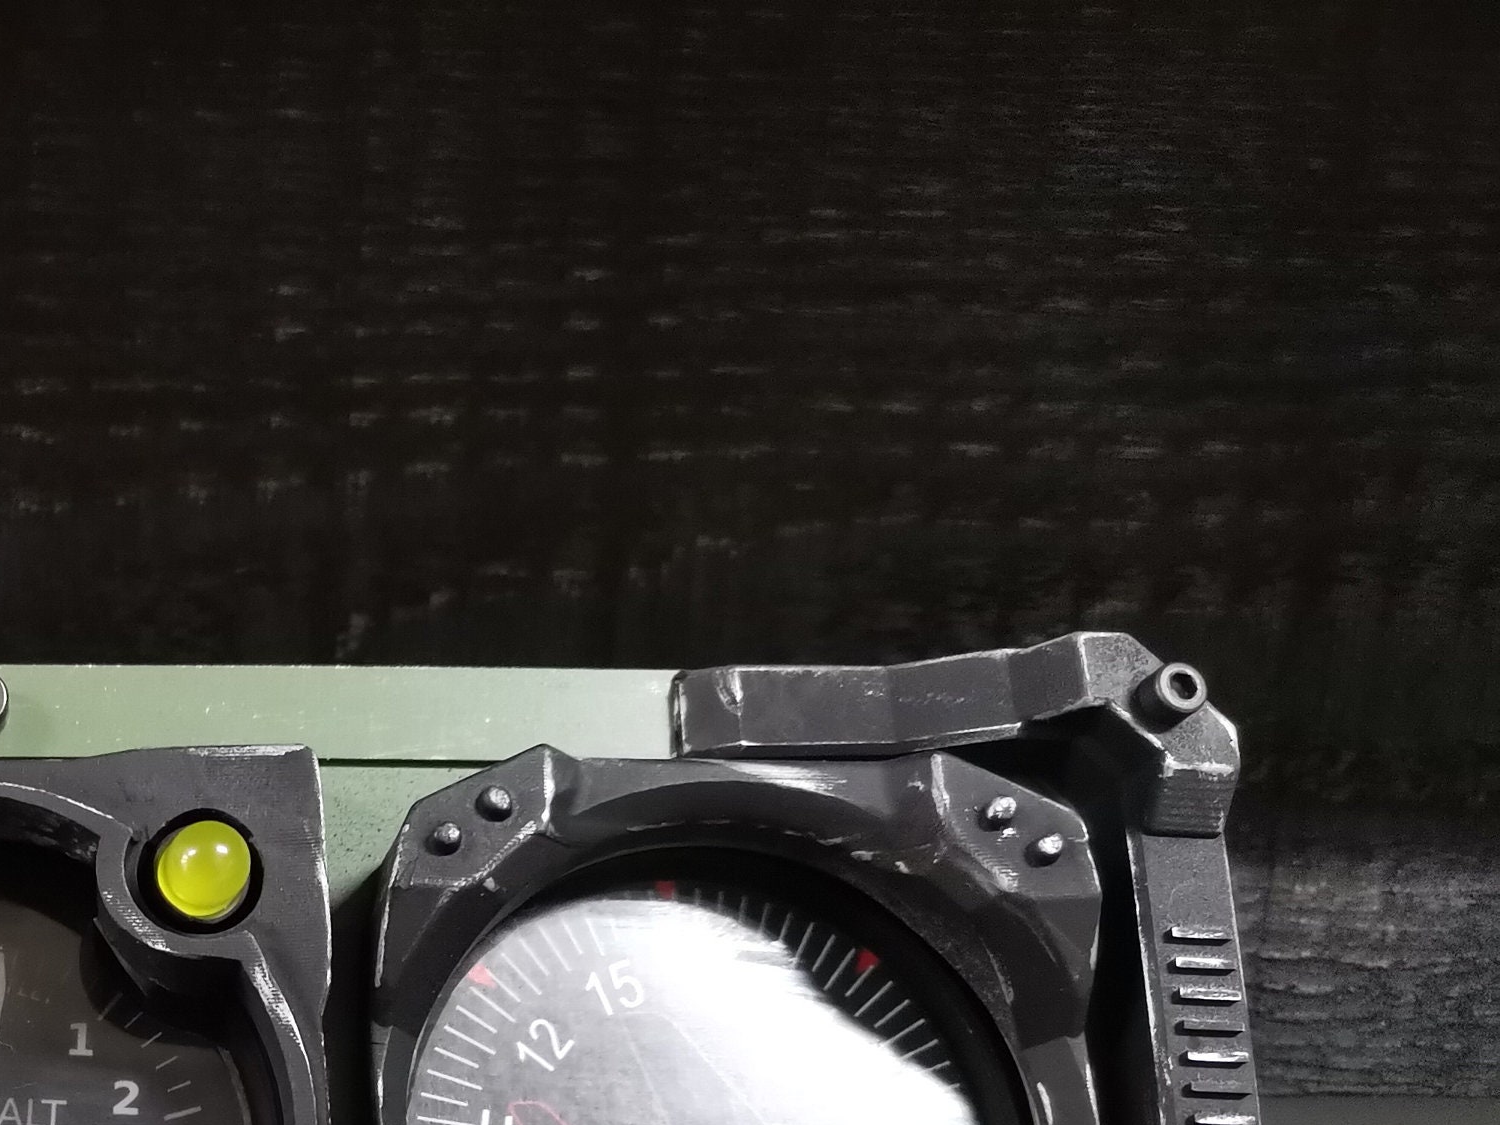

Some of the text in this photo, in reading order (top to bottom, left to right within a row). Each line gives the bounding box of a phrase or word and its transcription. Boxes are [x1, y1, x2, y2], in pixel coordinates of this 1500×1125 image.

[585, 959, 645, 1016] 15
[68, 1022, 94, 1056] 1
[516, 1018, 576, 1072] 12
[112, 1080, 140, 1116] 2
